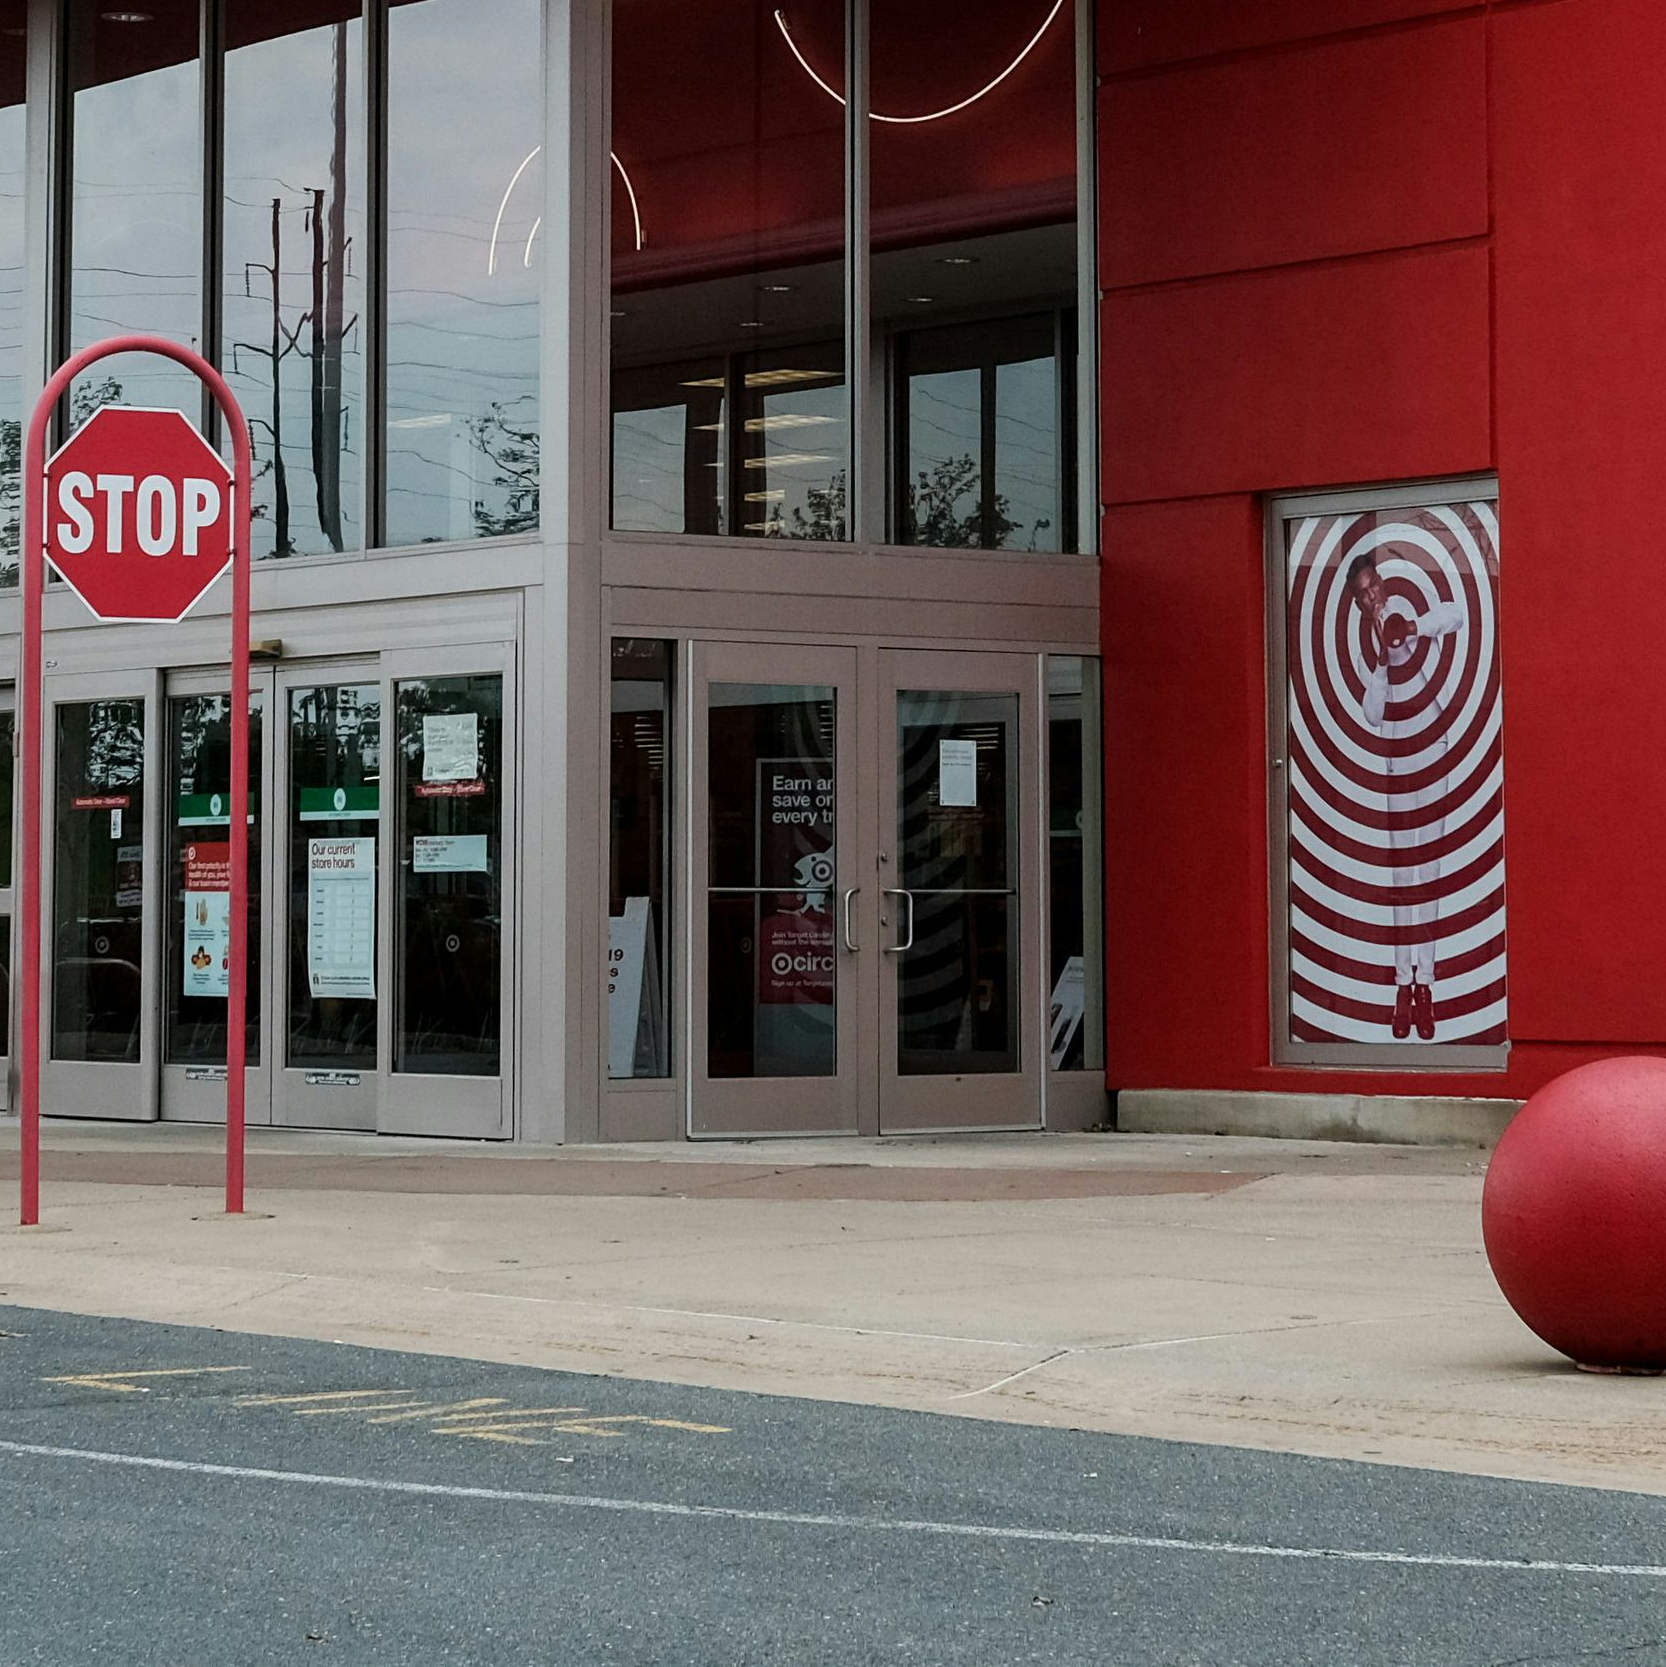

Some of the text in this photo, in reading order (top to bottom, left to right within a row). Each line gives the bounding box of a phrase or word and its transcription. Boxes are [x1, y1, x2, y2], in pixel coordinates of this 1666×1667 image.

[57, 471, 221, 557] STOP
[772, 775, 812, 791] Earn
[772, 795, 811, 807] save
[772, 811, 818, 826] every
[311, 843, 356, 855] Our current
[311, 857, 355, 869] store hours
[41, 1365, 733, 1446] LANE
